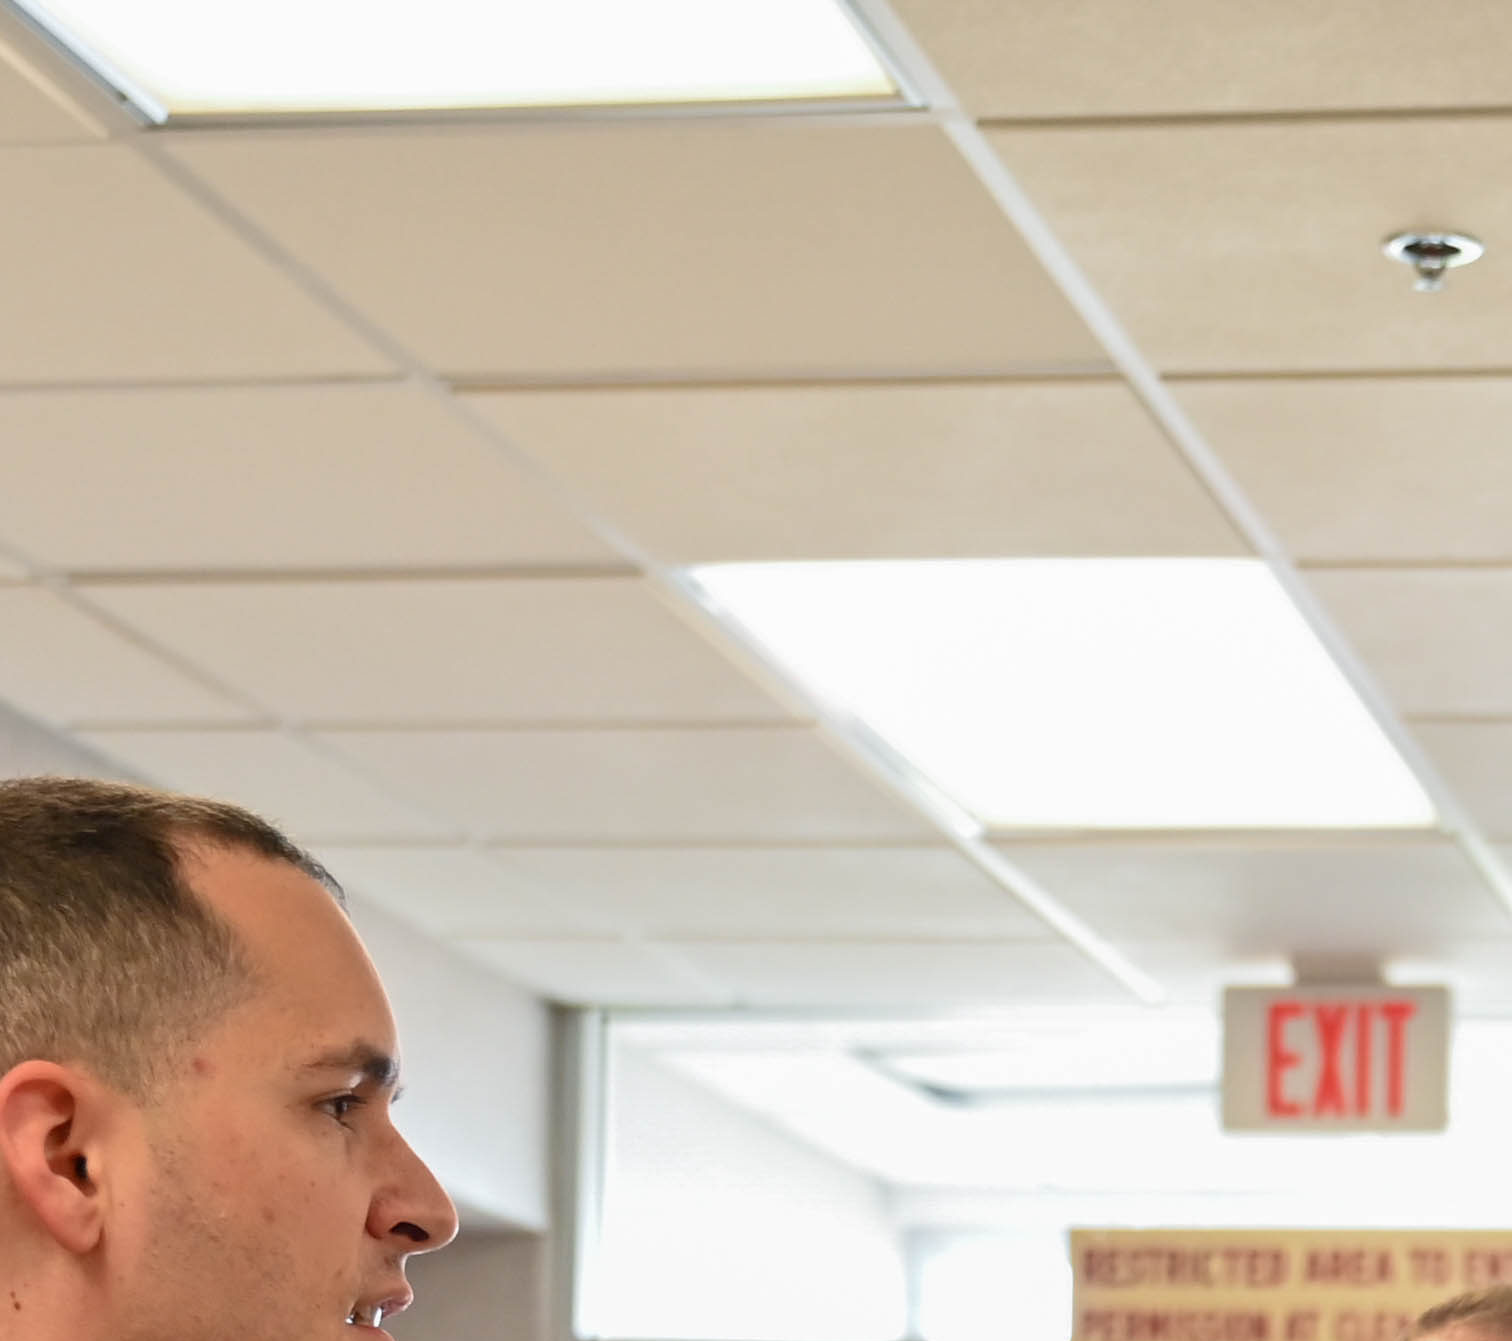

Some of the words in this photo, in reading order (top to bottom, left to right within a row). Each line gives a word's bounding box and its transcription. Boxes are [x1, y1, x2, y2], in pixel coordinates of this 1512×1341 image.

[1266, 1001, 1418, 1118] EXIT
[1083, 1245, 1285, 1288] RESTRICTED
[1303, 1246, 1392, 1286] AREA
[1406, 1246, 1450, 1286] TO
